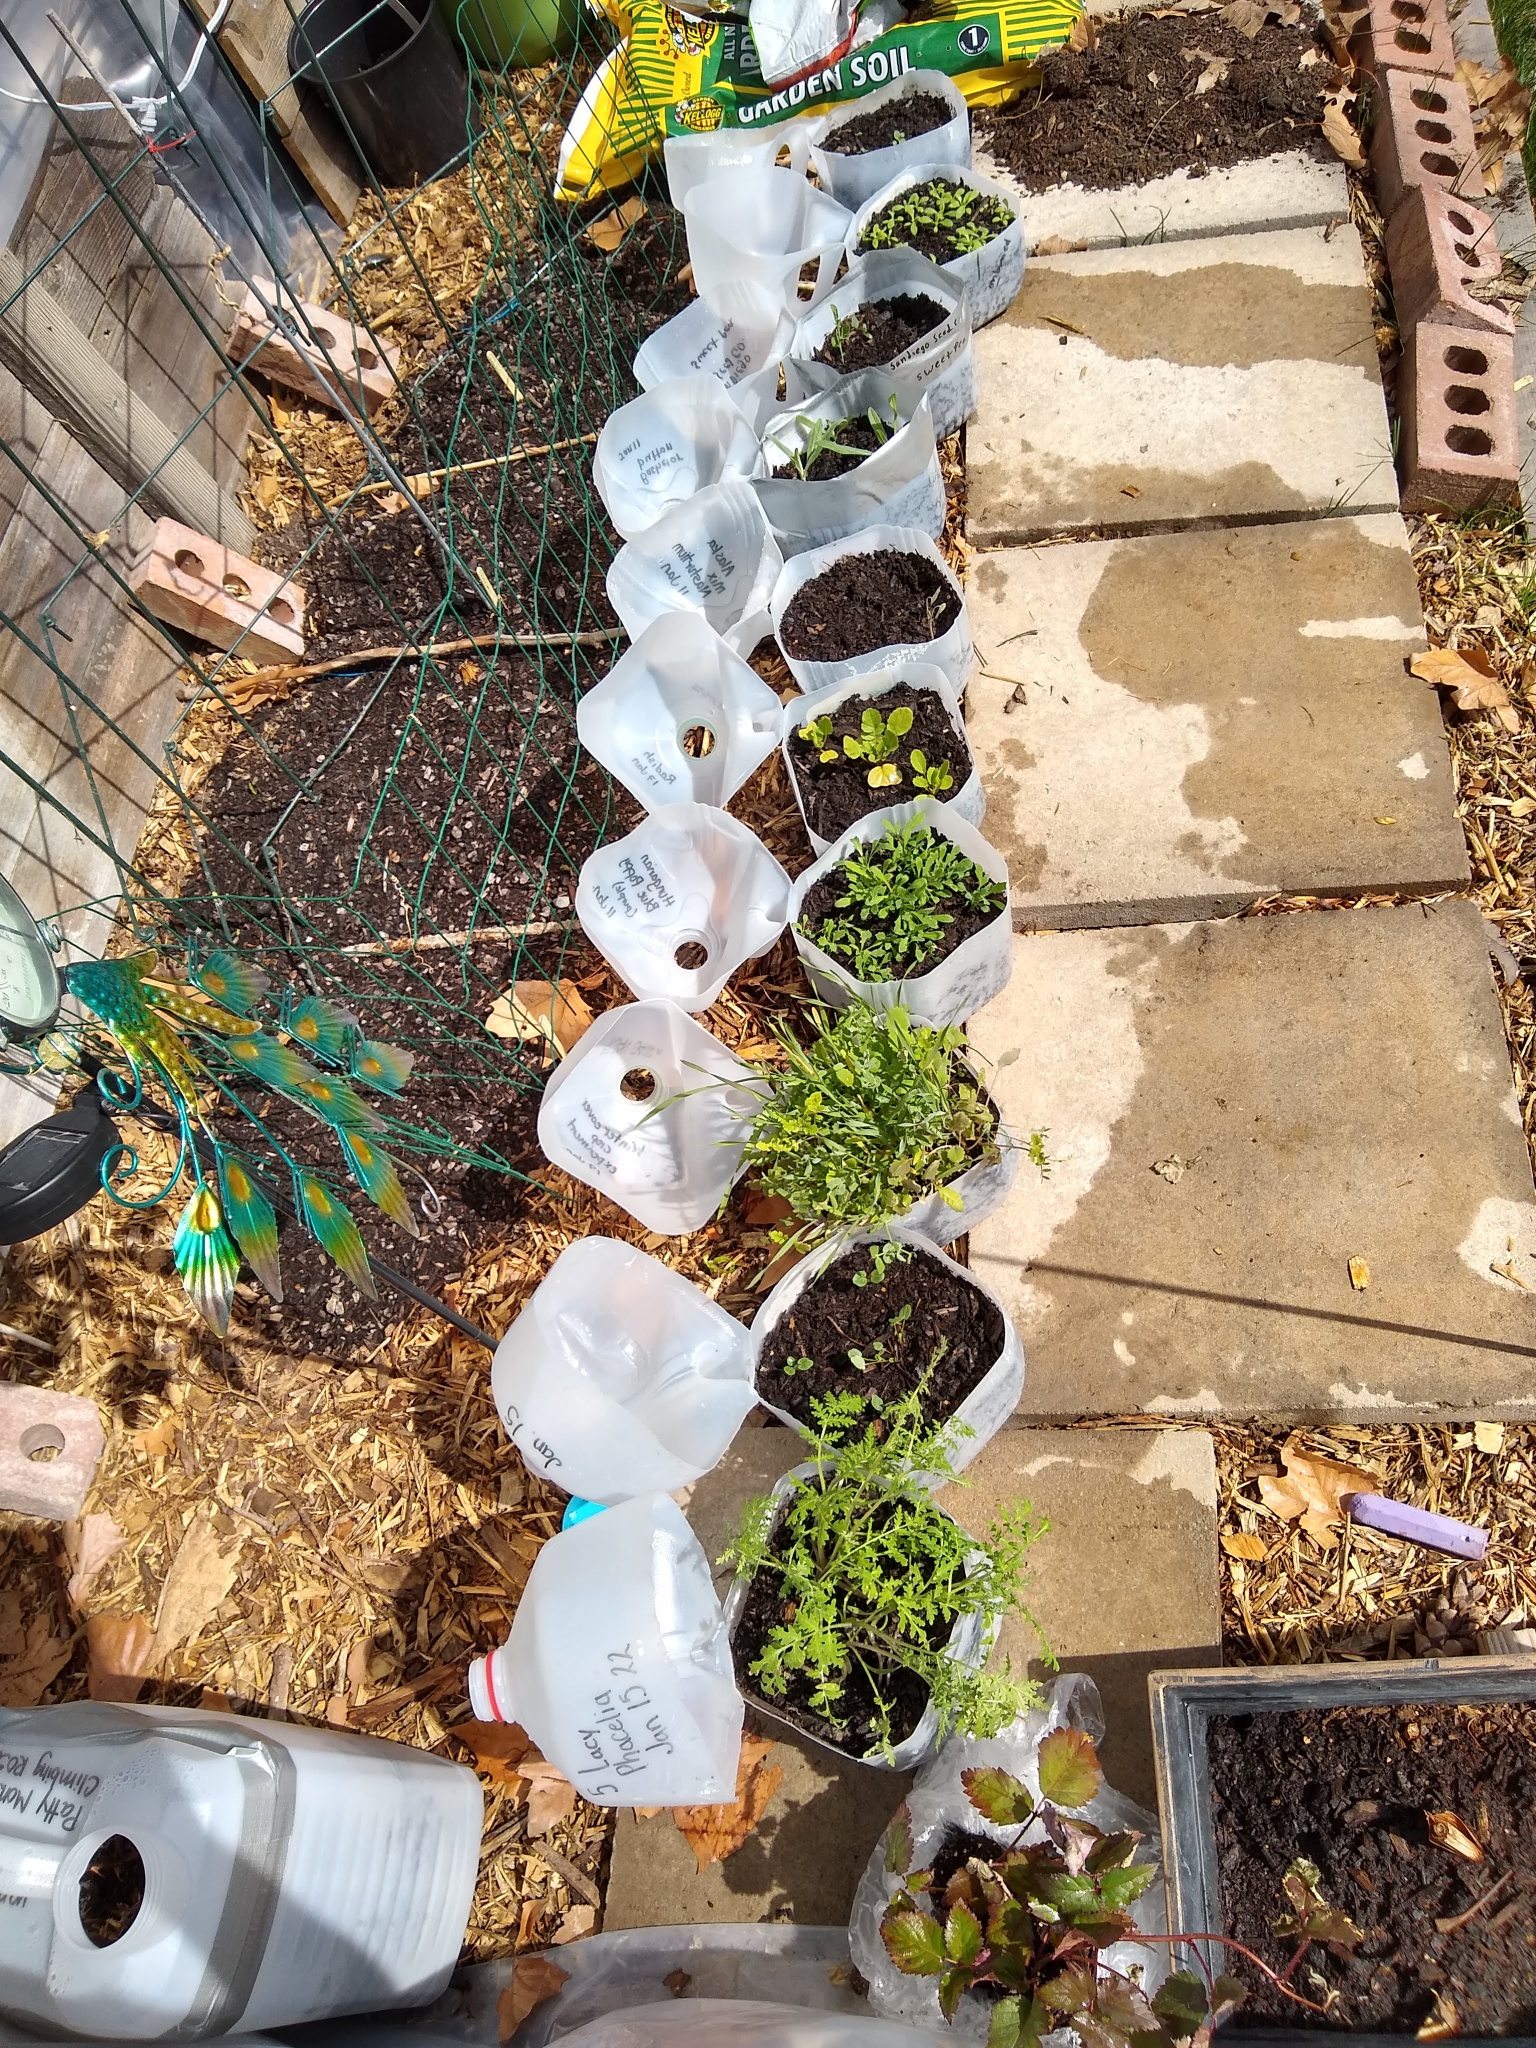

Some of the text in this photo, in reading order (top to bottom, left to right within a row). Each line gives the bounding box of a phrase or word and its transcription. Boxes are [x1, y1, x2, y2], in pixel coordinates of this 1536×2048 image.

[851, 46, 916, 87] SOIL
[684, 107, 722, 125] KELLOGG
[618, 1685, 651, 1711] 15
[578, 1729, 610, 1774] Lacy
[594, 1689, 648, 1776] Phacelia
[645, 1714, 674, 1755] Jan
[32, 1750, 100, 1798] Climbing
[0, 1783, 83, 1831] Patty Mon
